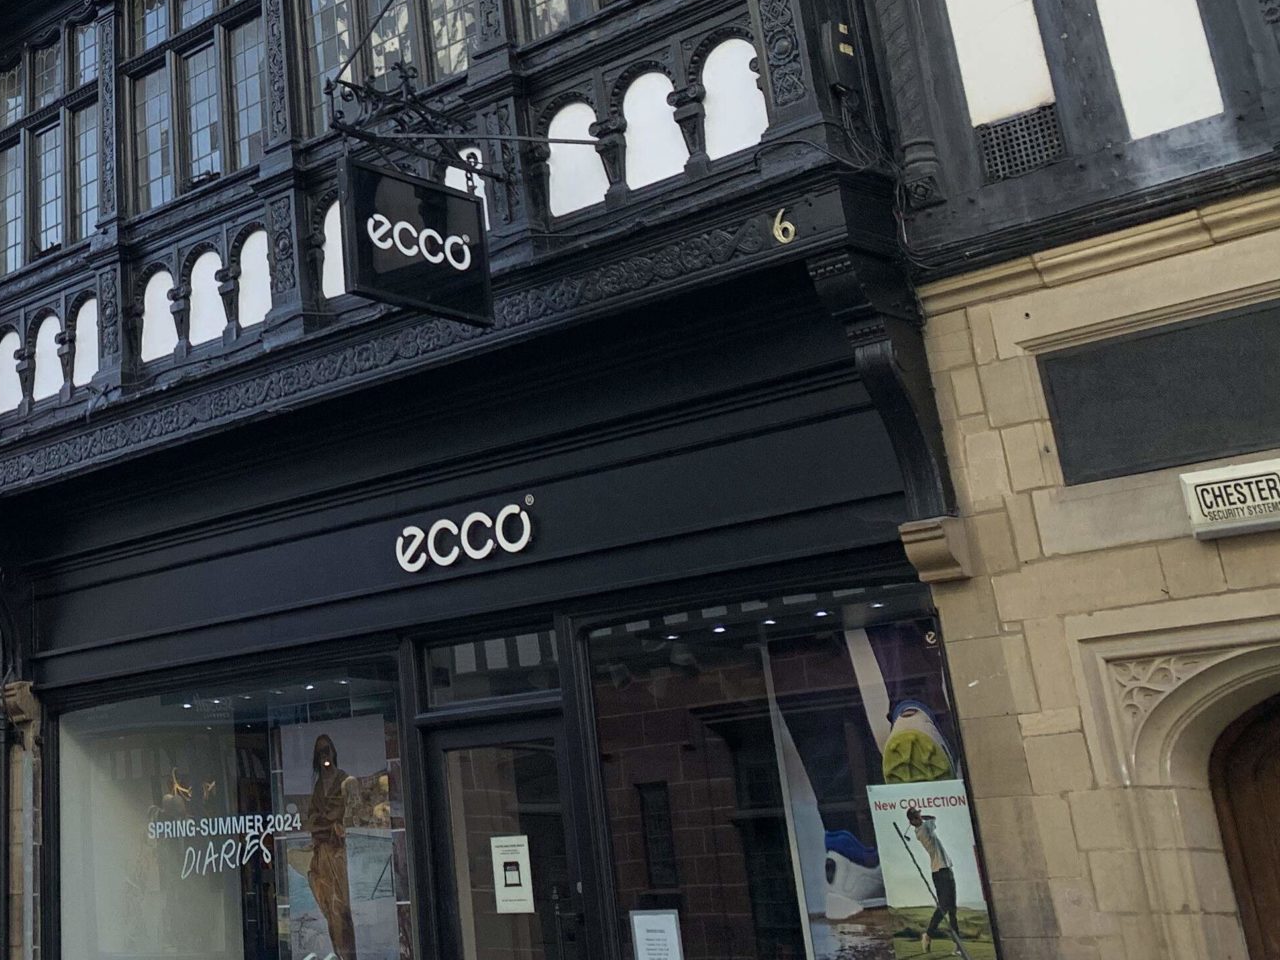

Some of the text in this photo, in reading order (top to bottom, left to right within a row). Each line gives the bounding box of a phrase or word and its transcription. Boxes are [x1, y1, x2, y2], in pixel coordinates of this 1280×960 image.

[367, 213, 471, 271] ecco
[773, 207, 796, 244] 6
[1200, 478, 1280, 509] CHESTER
[1207, 507, 1245, 521] SECURITY
[395, 503, 531, 573] ecco
[874, 795, 967, 811] New COLLECTION
[147, 813, 302, 839] SPRING-SUMMER 2024
[180, 829, 272, 880] DIARIES
